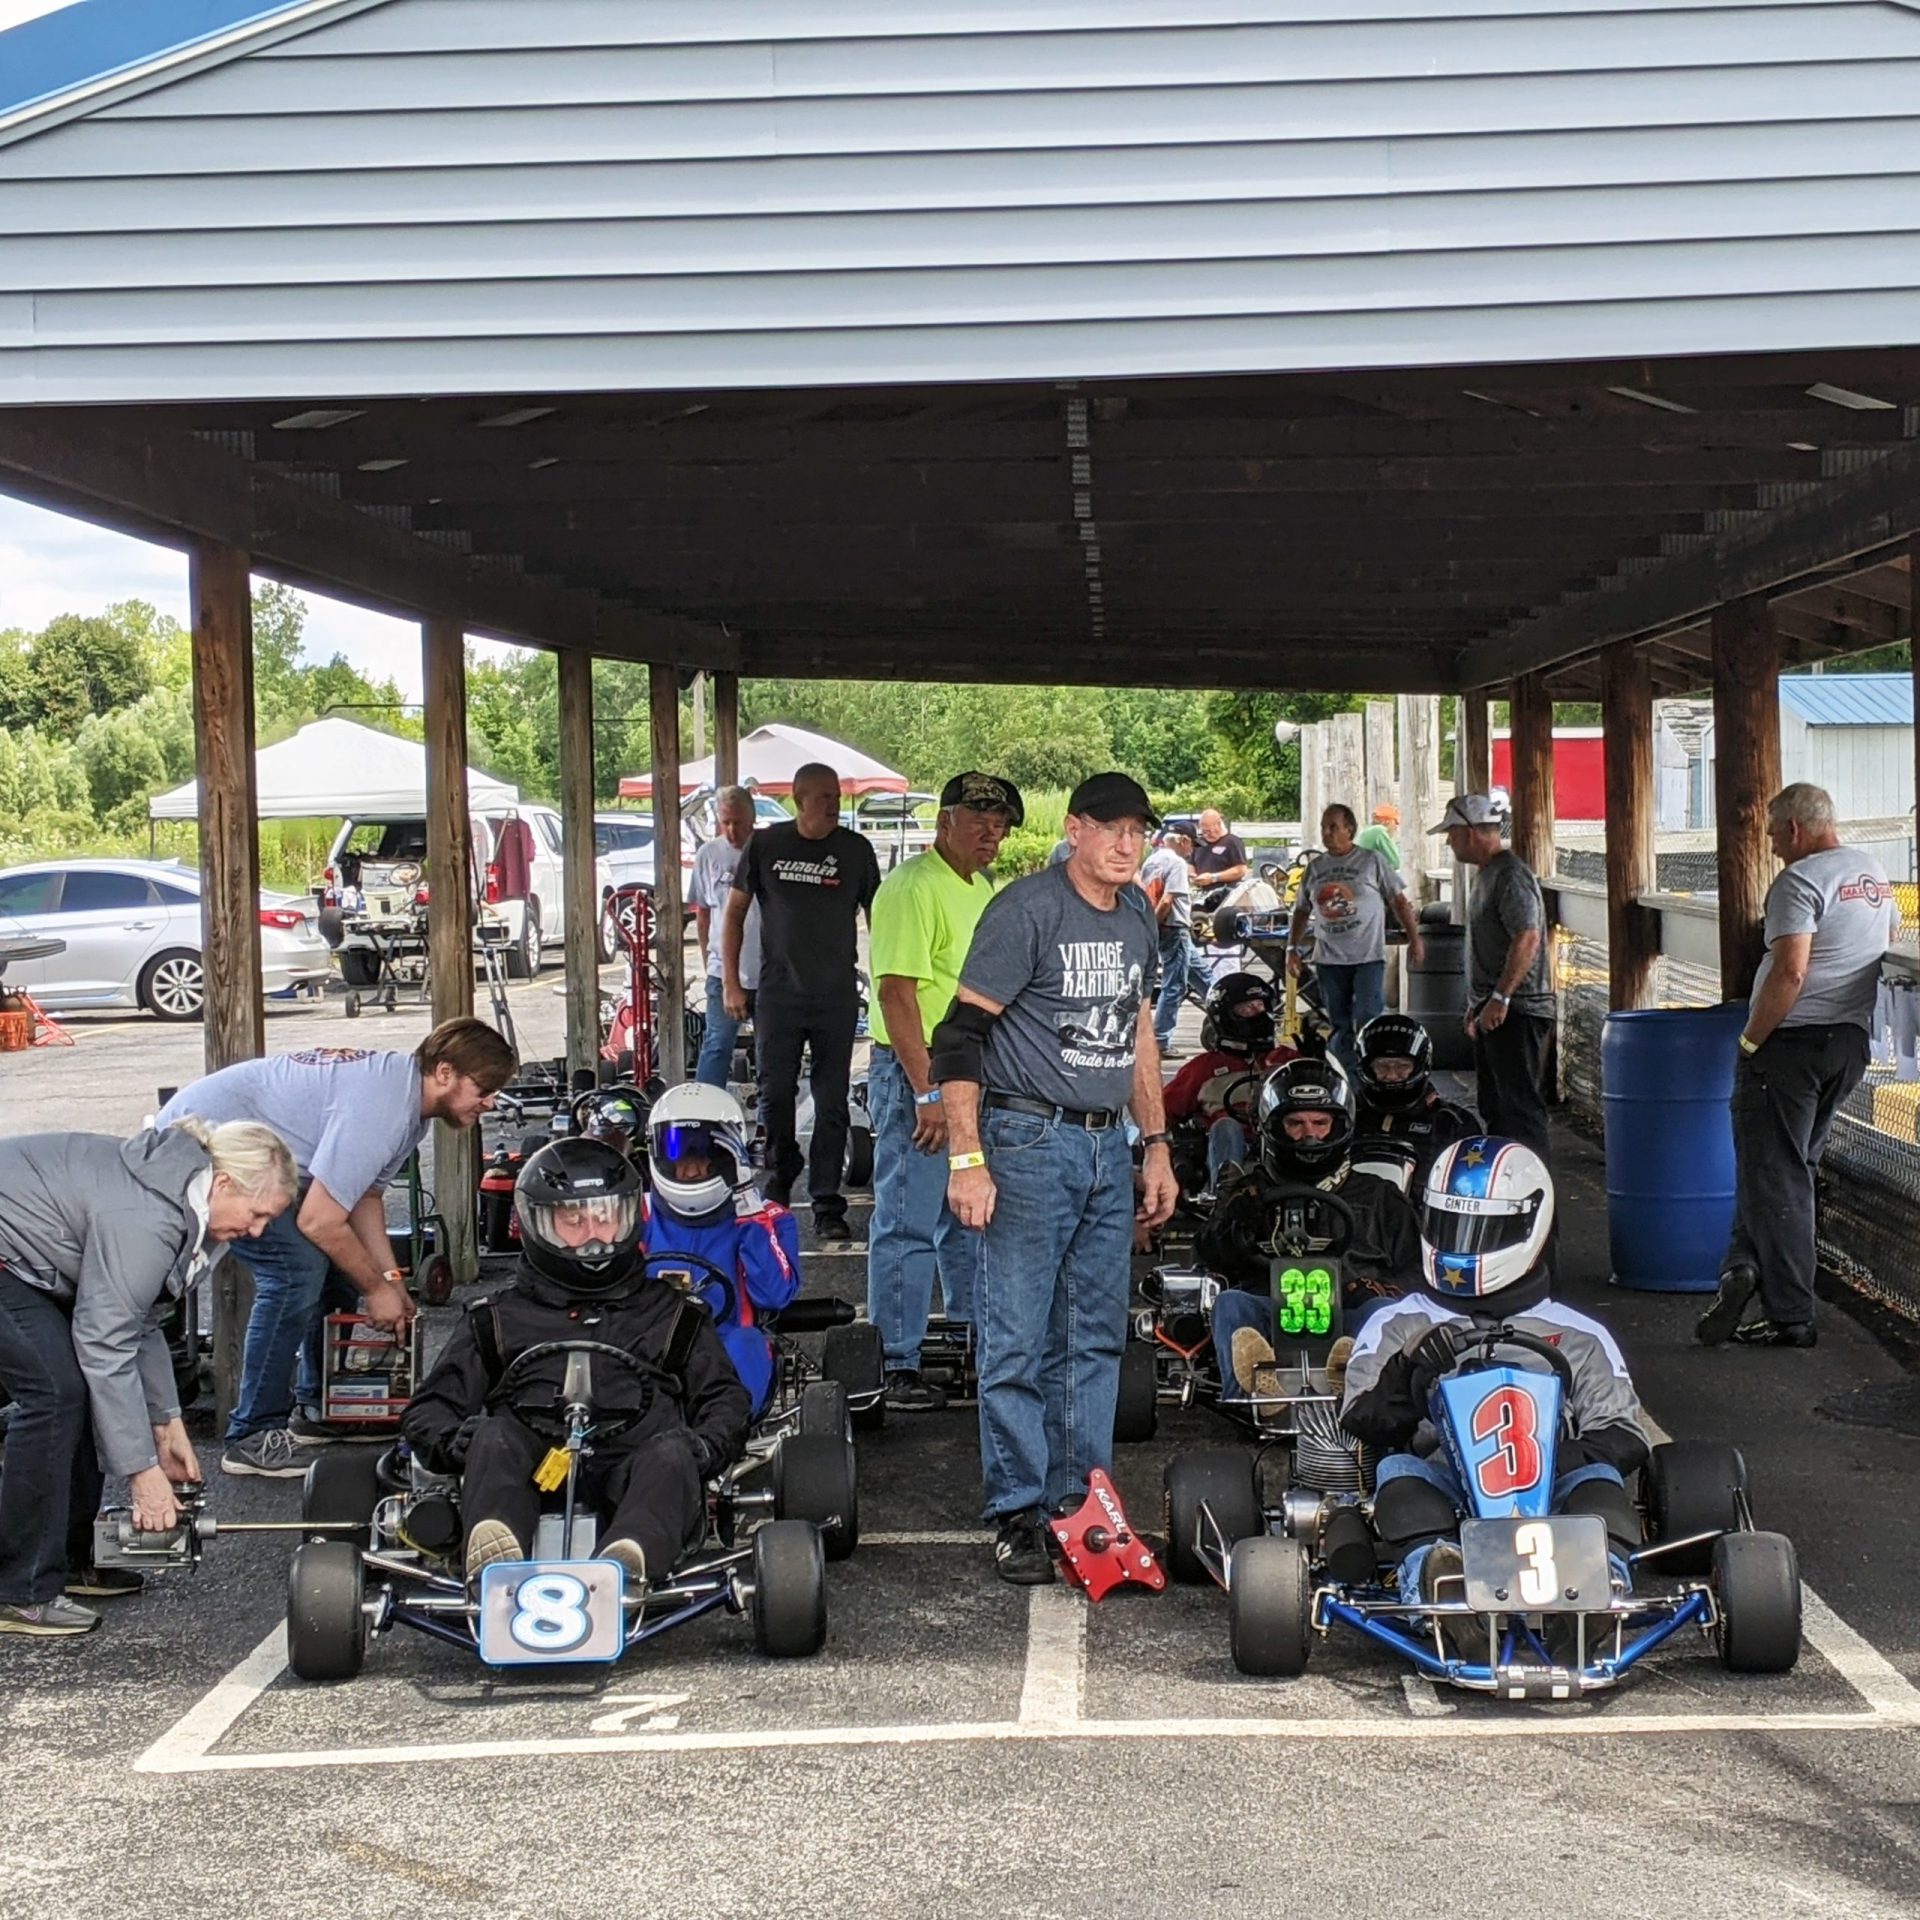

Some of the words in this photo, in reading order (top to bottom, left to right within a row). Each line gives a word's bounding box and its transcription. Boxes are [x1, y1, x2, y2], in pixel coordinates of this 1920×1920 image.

[779, 871, 822, 885] RACING
[1058, 941, 1125, 970] VINTAGE
[1061, 969, 1126, 998] KARTING
[1060, 1048, 1104, 1068] Made
[1103, 1053, 1117, 1067] in
[1444, 1196, 1481, 1213] GINTER
[1280, 1268, 1331, 1334] 33
[1471, 1384, 1544, 1500] 3
[1094, 1487, 1128, 1535] KARL
[1515, 1522, 1559, 1605] 3
[510, 1572, 594, 1655] 8
